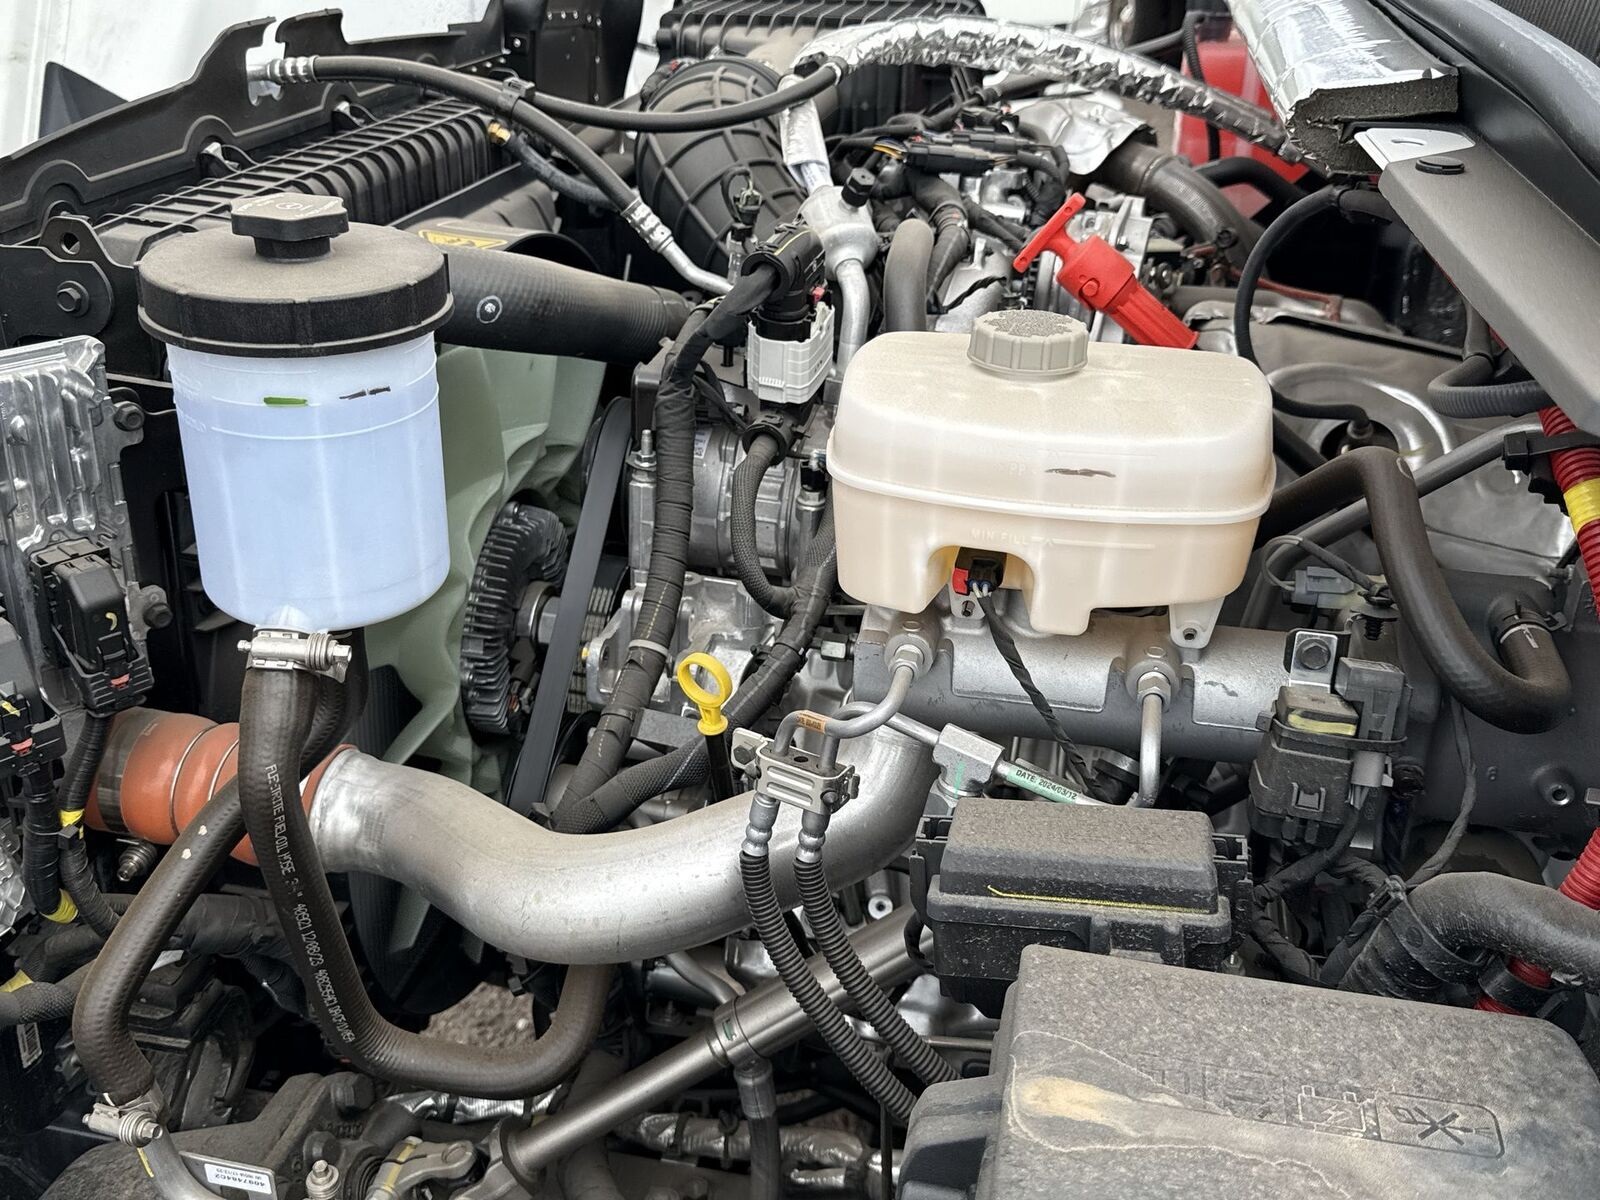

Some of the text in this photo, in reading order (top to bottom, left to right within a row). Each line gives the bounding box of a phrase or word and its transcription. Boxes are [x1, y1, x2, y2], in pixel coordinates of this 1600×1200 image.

[970, 528, 1028, 546] MIN FILL
[1015, 769, 1078, 800] DATE: 2024/03/12
